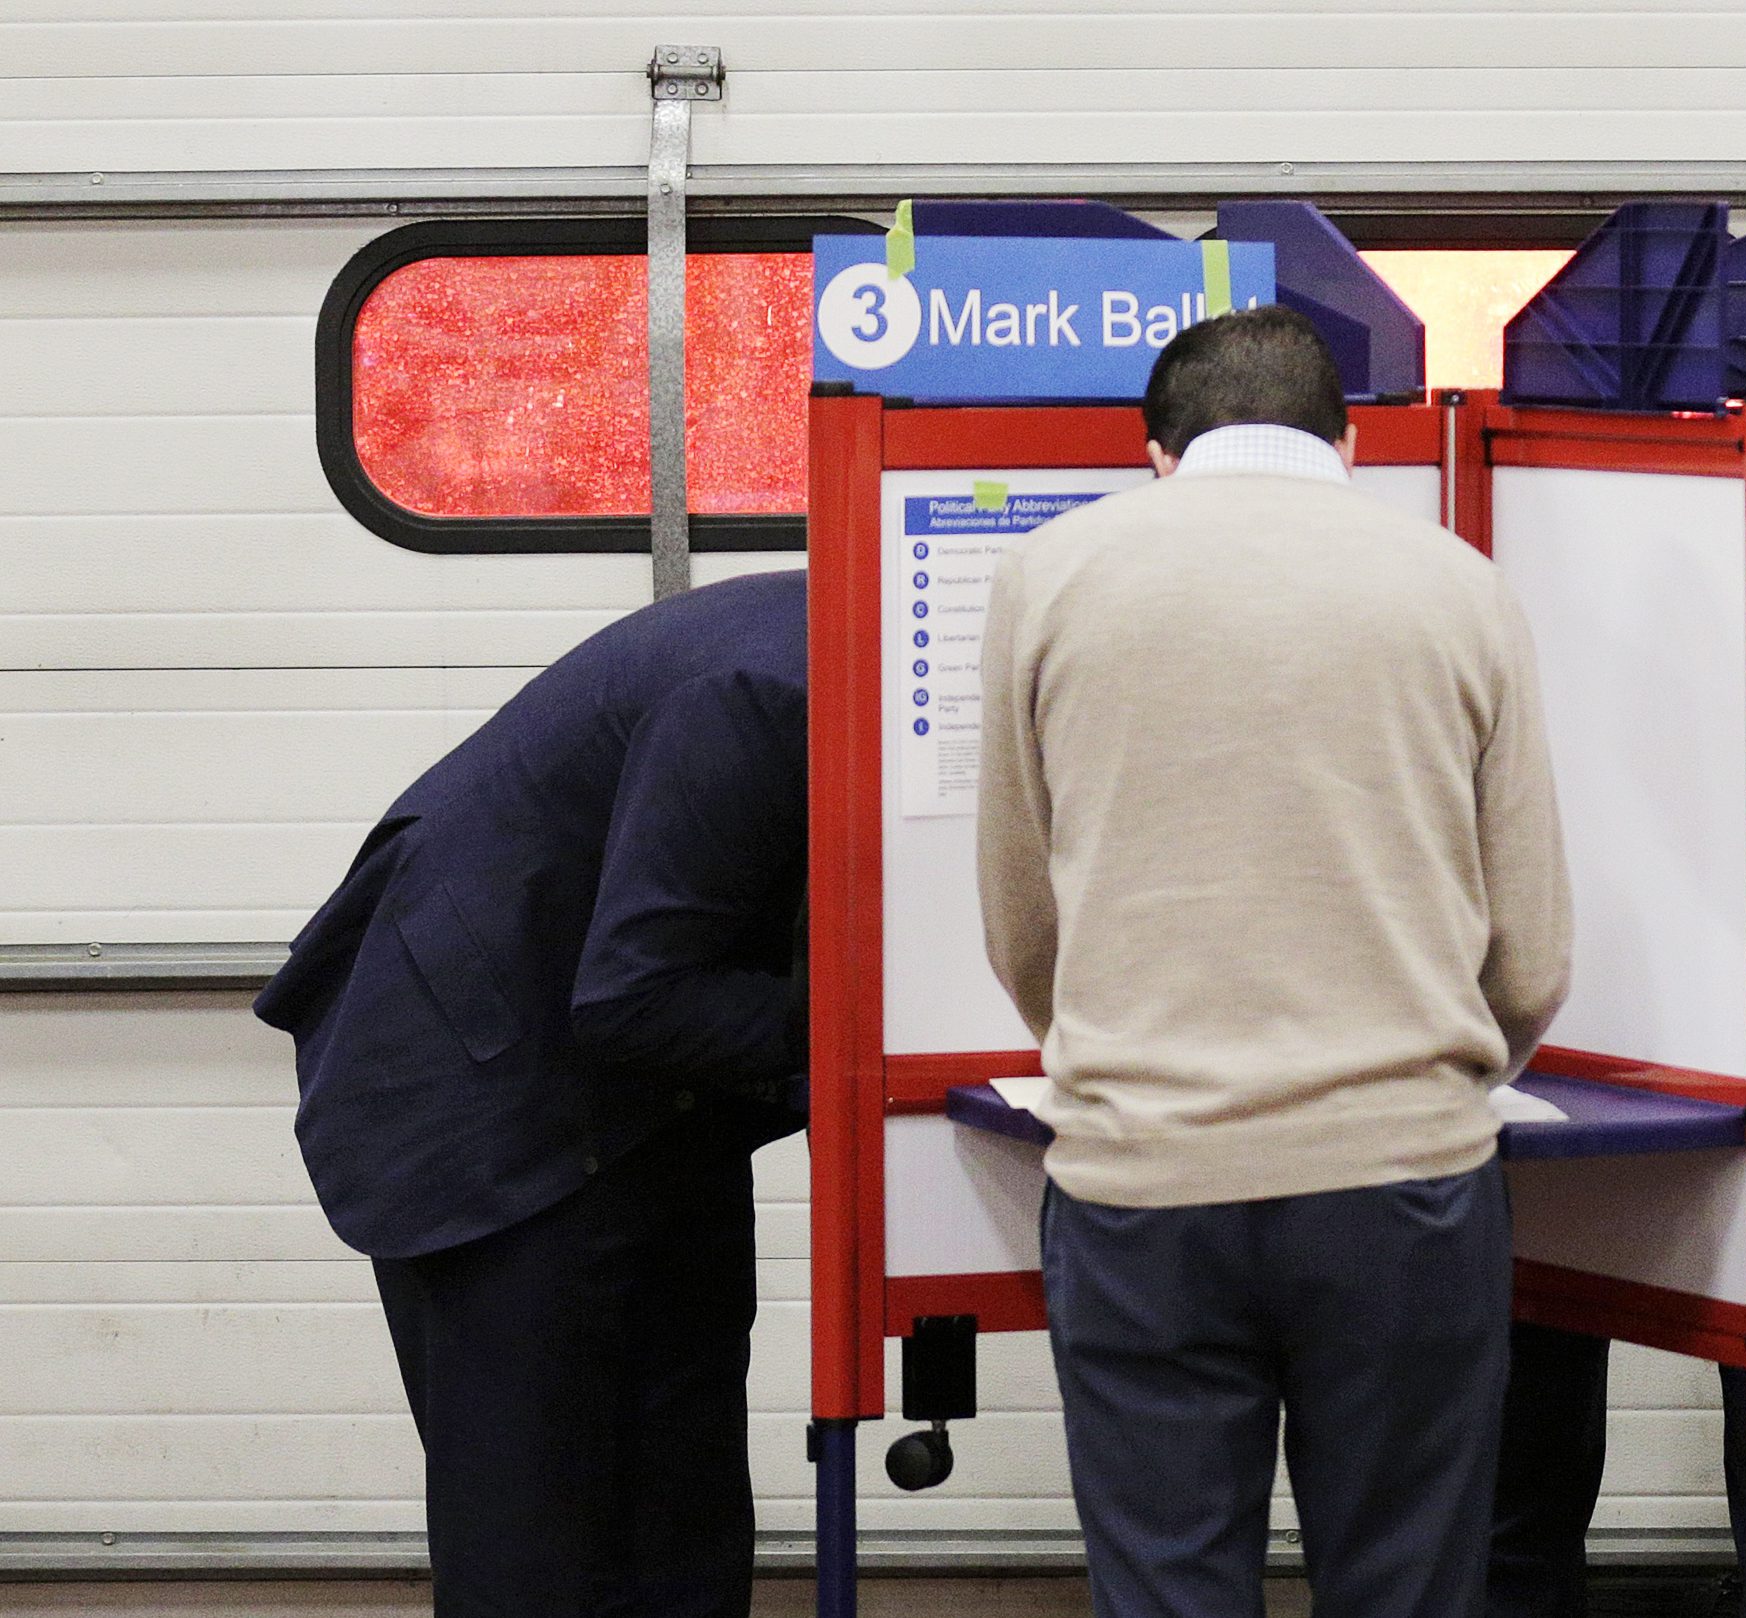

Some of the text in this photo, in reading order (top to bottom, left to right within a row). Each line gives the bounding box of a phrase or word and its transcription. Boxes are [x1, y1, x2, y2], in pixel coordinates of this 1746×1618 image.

[851, 283, 1258, 348] 3 Mark Ball
[929, 499, 976, 515] Political
